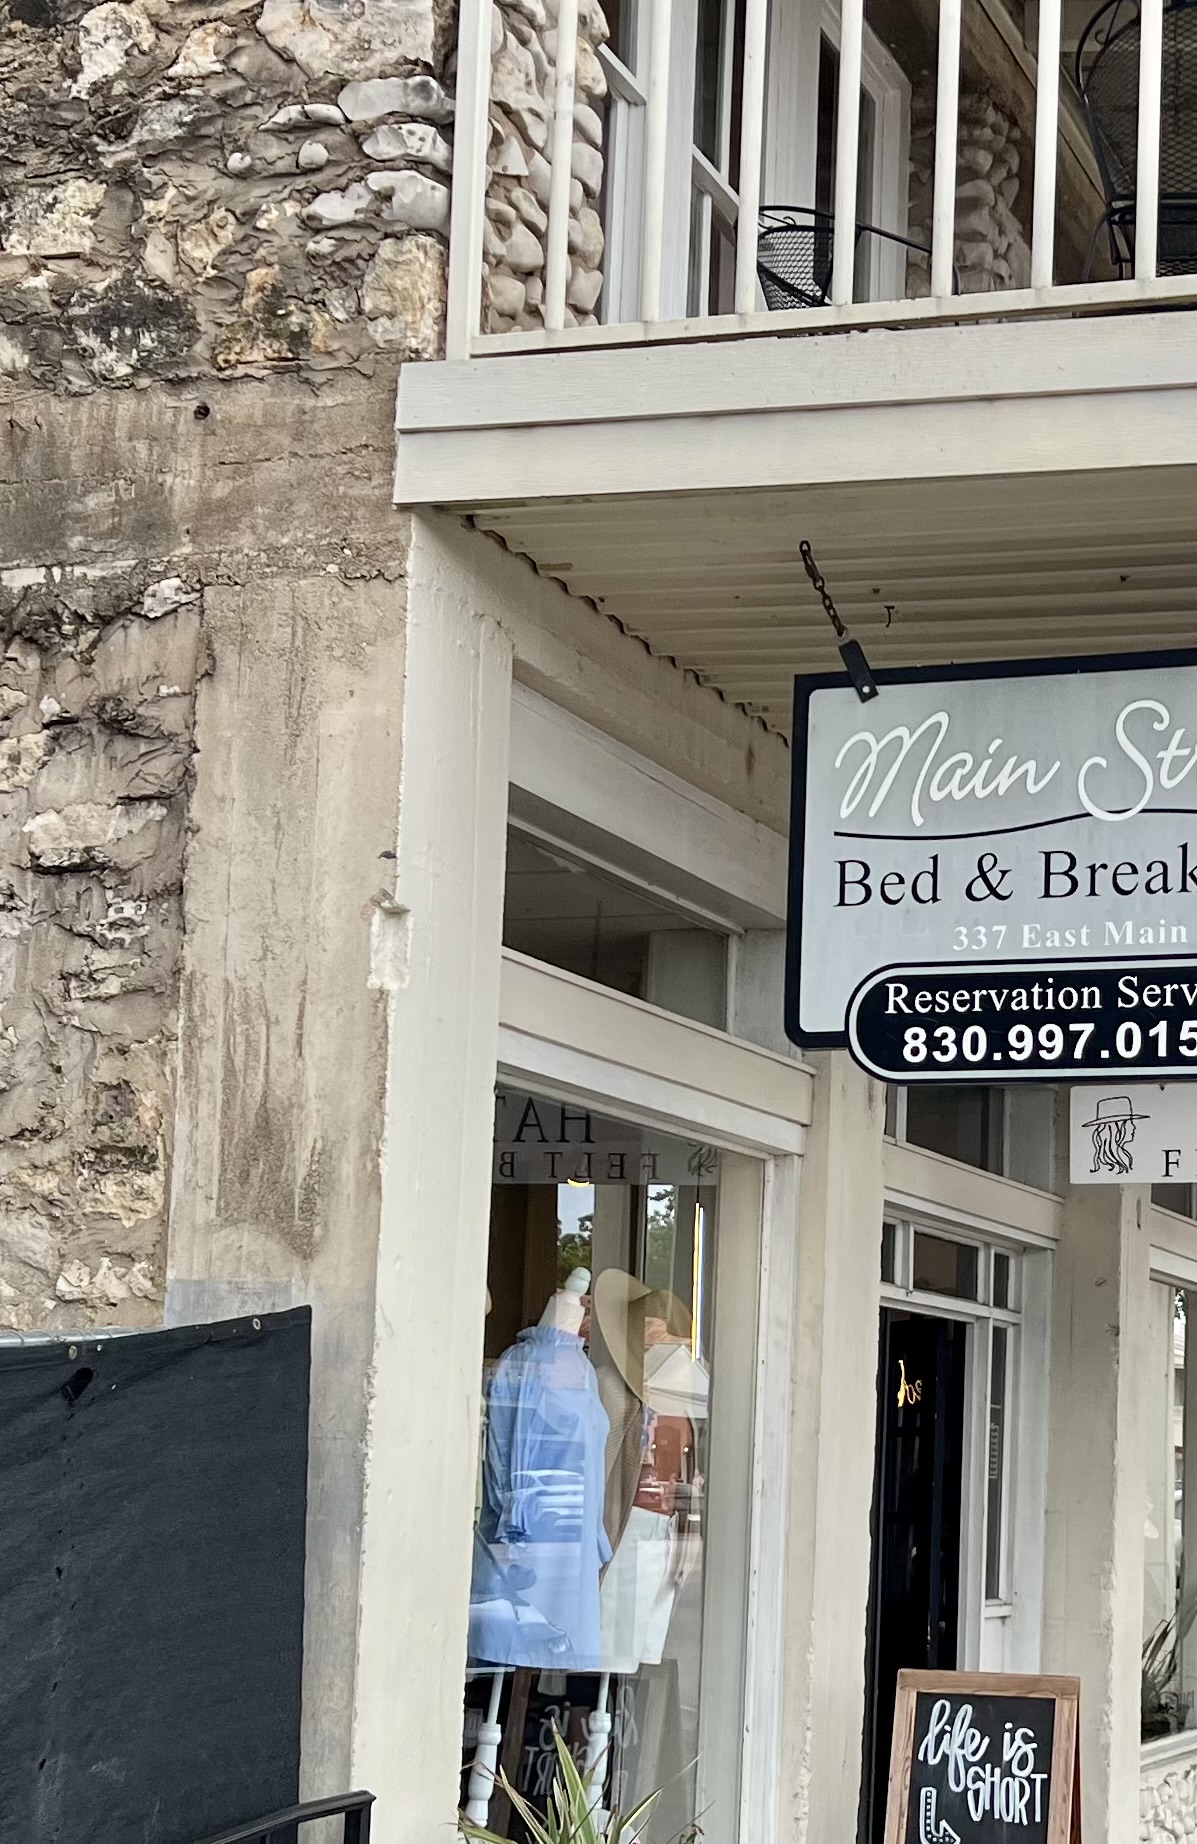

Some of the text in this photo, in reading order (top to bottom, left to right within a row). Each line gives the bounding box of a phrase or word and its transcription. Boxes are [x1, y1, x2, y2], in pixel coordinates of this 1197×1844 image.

[834, 711, 1060, 827] Main
[834, 853, 940, 907] Bed
[964, 851, 1014, 904] &
[952, 919, 1188, 951] 337 East Main
[884, 976, 1103, 1015] Reservation
[1003, 1722, 1038, 1777] is
[967, 1763, 1048, 1826] SHORT
